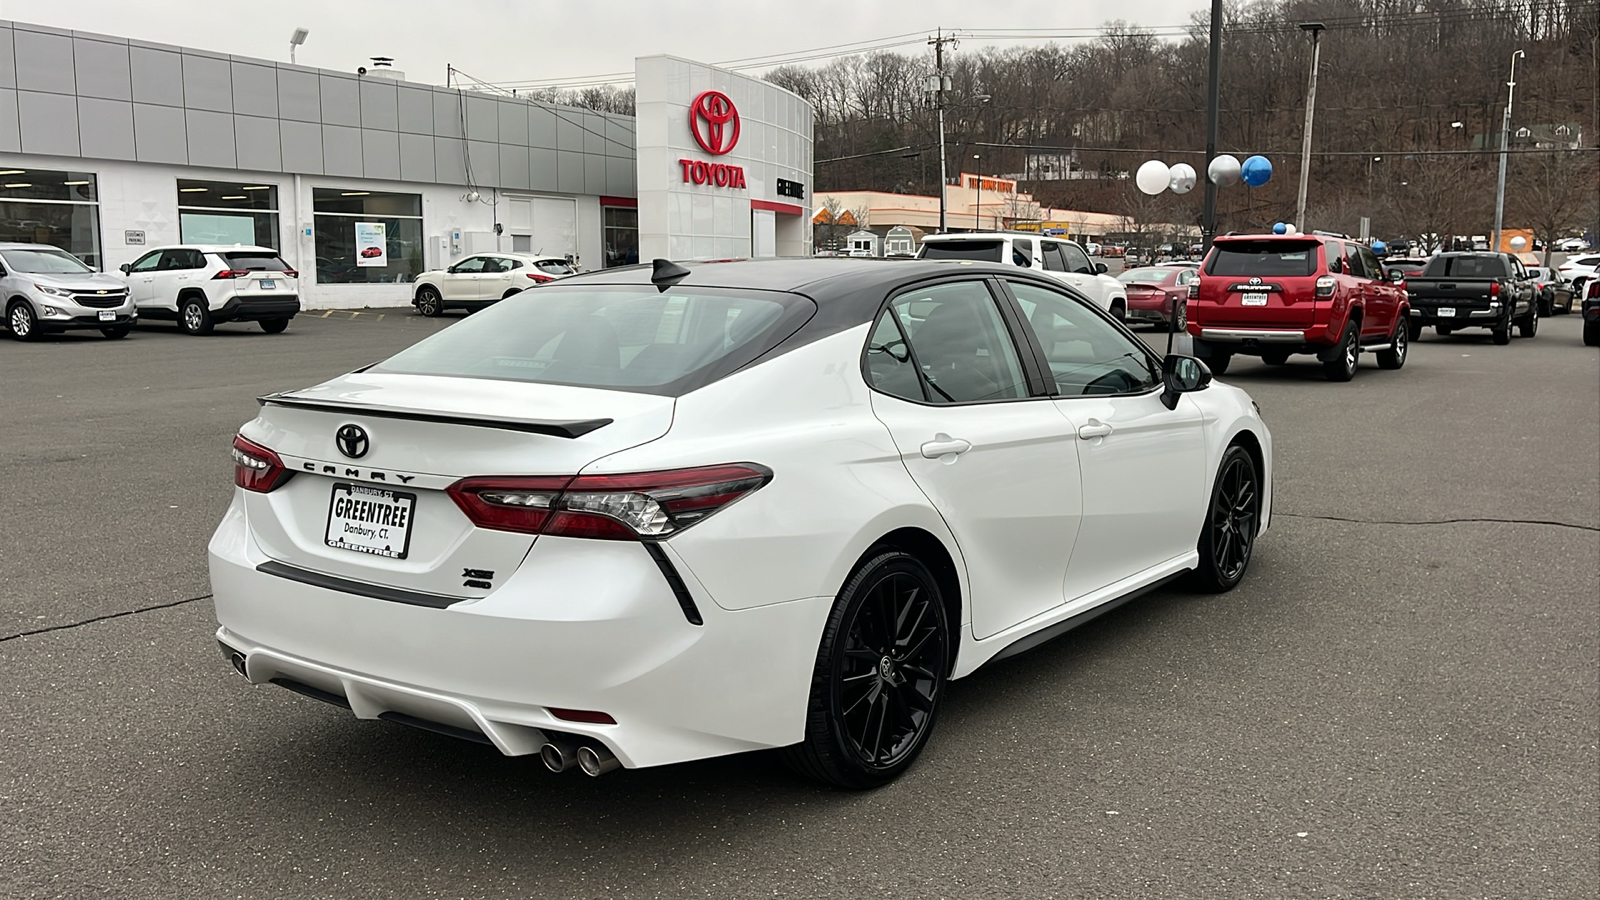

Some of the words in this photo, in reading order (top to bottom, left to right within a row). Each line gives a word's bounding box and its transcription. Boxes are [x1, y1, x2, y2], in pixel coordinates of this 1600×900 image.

[679, 159, 747, 189] TOYOTA
[303, 462, 415, 483] CAMRY
[335, 497, 408, 528] GREENTREE
[344, 522, 377, 540] Danbury,
[378, 528, 389, 539] CT.
[327, 540, 399, 558] GREENTREE
